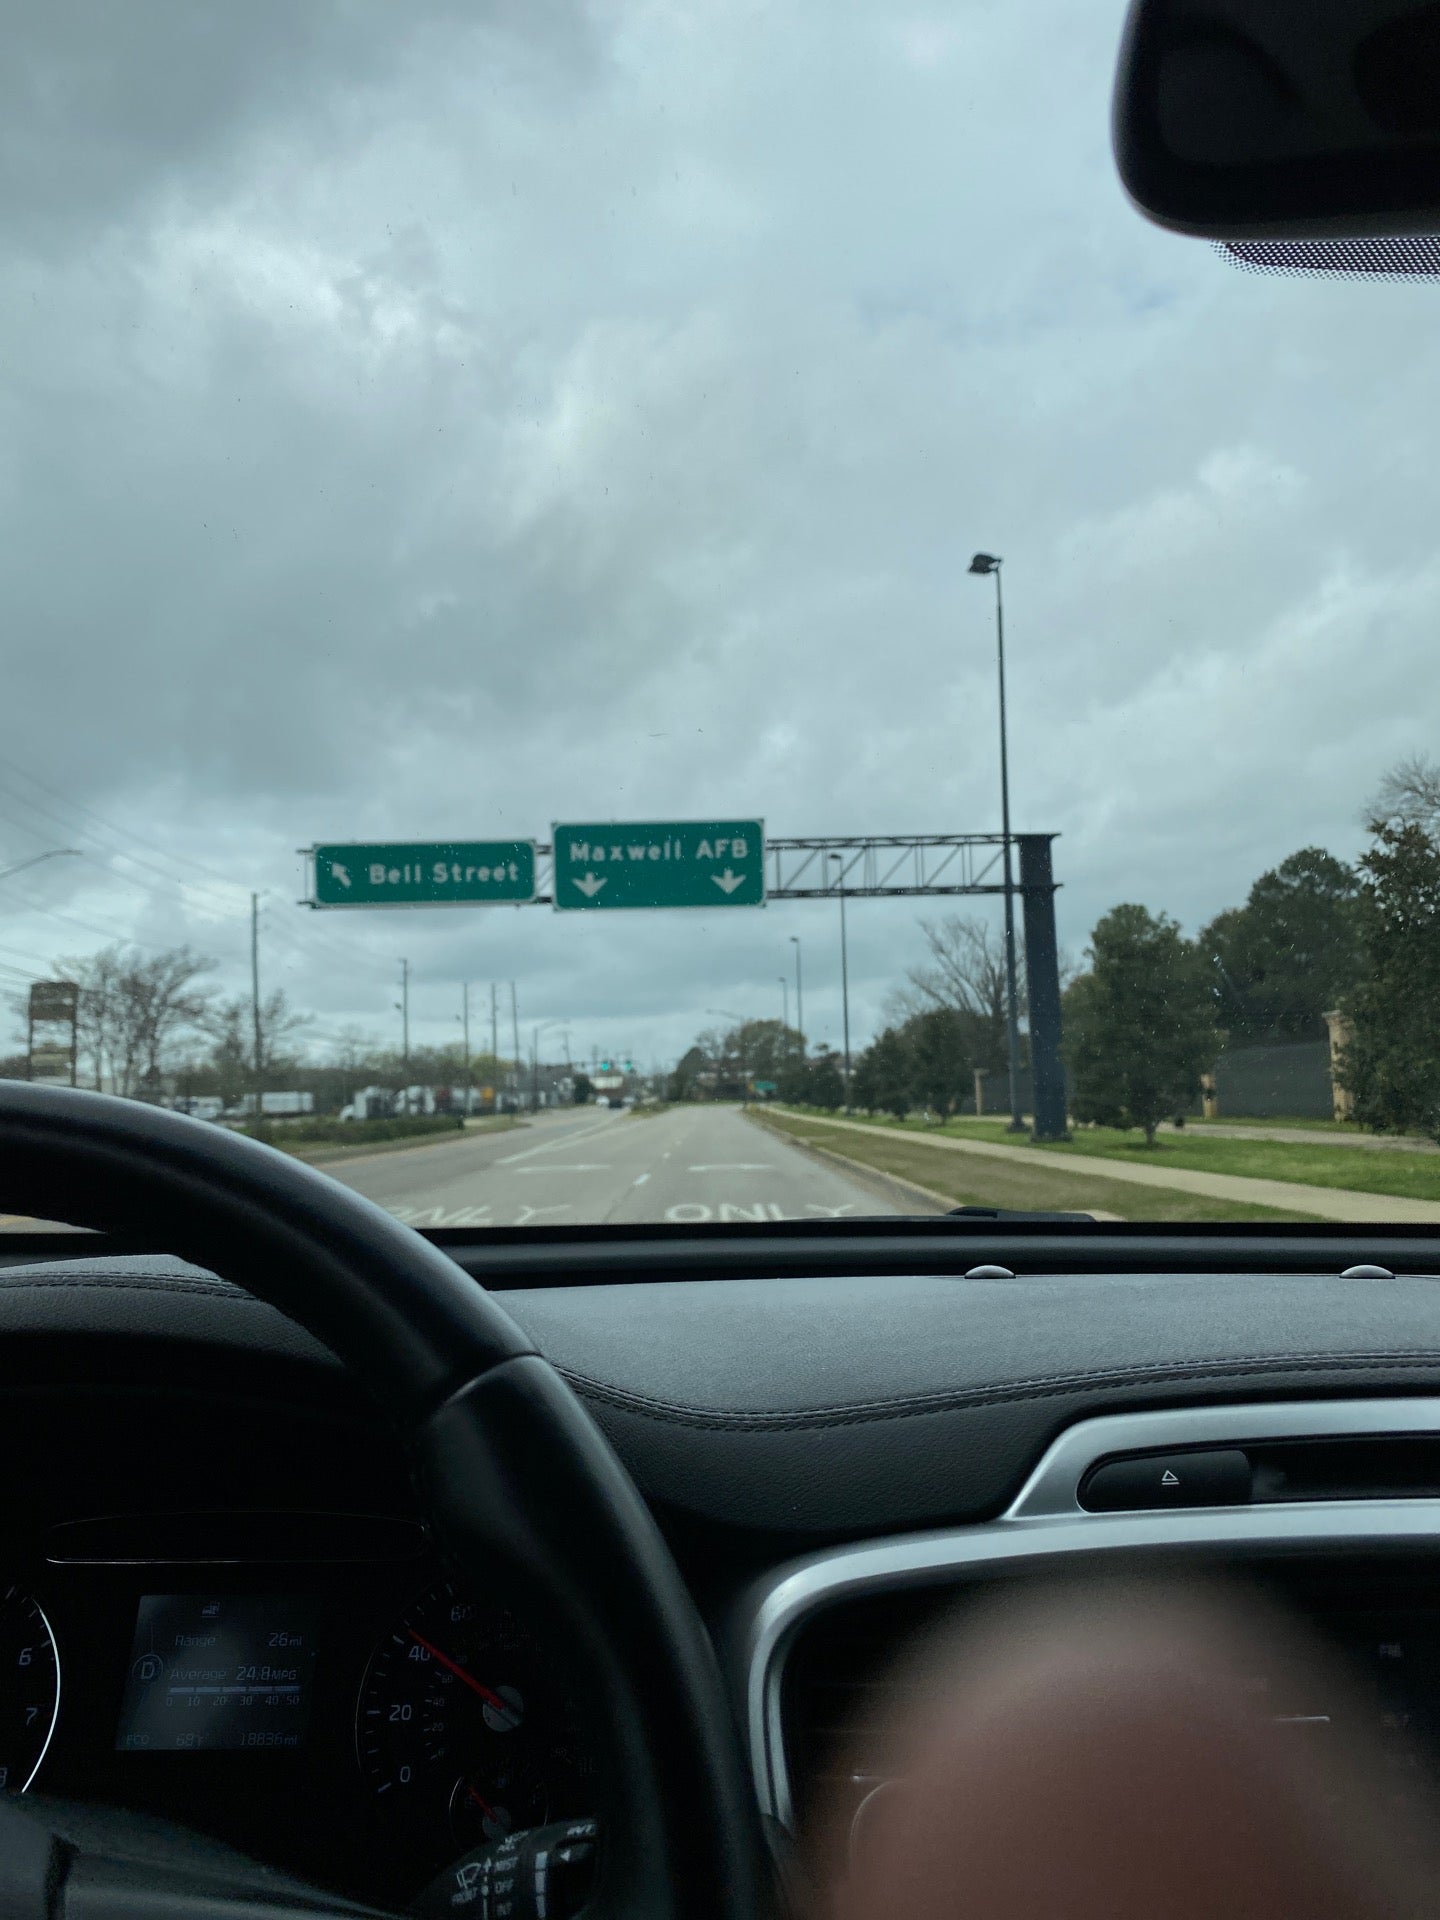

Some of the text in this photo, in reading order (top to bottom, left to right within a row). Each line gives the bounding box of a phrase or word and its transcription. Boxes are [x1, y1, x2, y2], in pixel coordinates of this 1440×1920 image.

[570, 837, 749, 862] Maxwell AFB
[369, 862, 519, 885] Bell Street
[664, 1202, 855, 1223] ONLY
[174, 1634, 217, 1648] Range
[18, 1647, 33, 1666] 6
[140, 1661, 156, 1680] D
[169, 1668, 227, 1681] Average
[25, 1707, 38, 1726] 7
[389, 1704, 412, 1721] 20
[400, 1766, 411, 1782] 0
